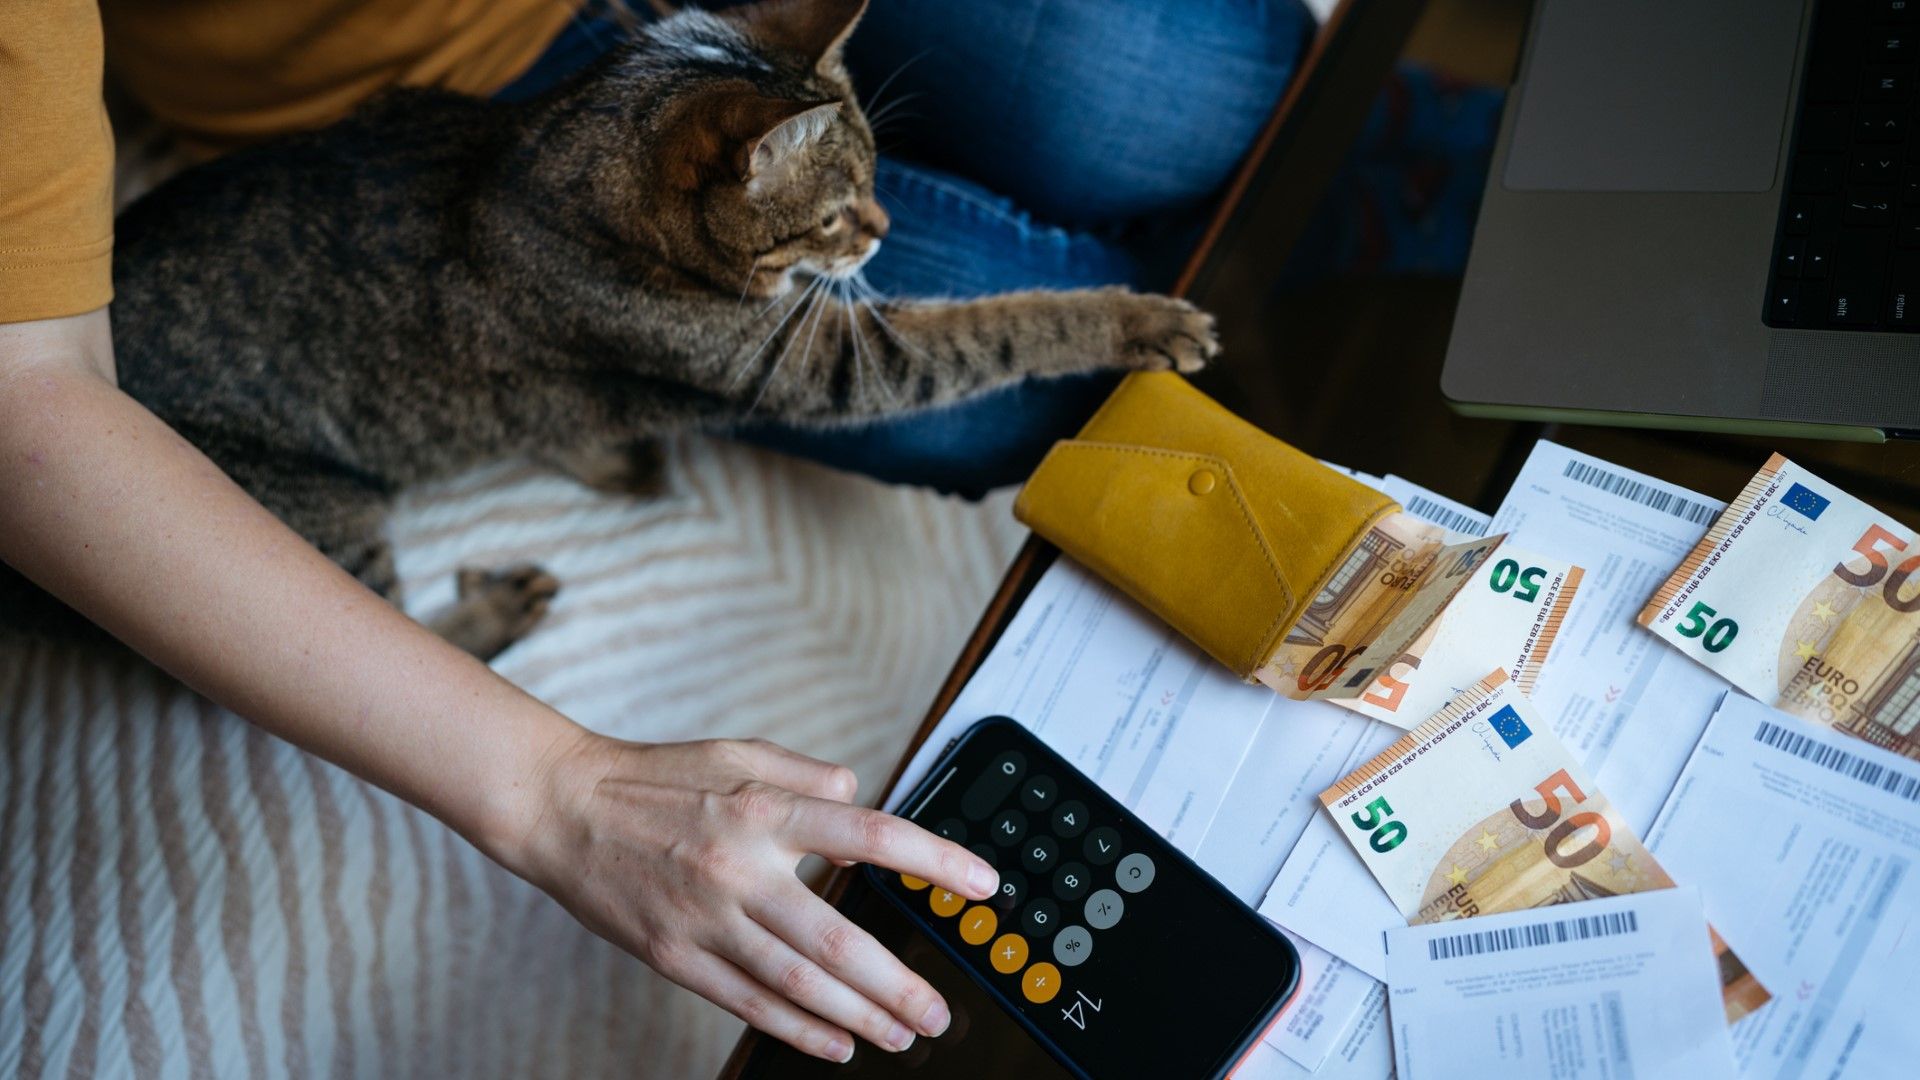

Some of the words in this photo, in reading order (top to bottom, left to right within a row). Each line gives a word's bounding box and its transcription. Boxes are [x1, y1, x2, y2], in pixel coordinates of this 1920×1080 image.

[1887, 40, 1900, 48] N
[1881, 79, 1895, 88] M
[1836, 298, 1848, 316] shift
[1895, 294, 1905, 319] return
[1674, 593, 1688, 608] ECB
[1697, 566, 1711, 580] EZB
[1708, 551, 1721, 566] EKP
[1730, 524, 1744, 539] ESB
[1741, 510, 1756, 525] EKB
[1765, 482, 1779, 497] EBC
[1834, 523, 1920, 613] 50
[1489, 558, 1548, 604] 50
[1544, 592, 1555, 607] ECB
[1530, 623, 1541, 638] EZB
[1674, 600, 1740, 654] 50
[1523, 638, 1534, 653] EKP
[1803, 656, 1859, 695] EURO
[1357, 784, 1373, 797] ECB
[1388, 763, 1403, 776] EZB
[1402, 752, 1417, 766] EKP
[1431, 732, 1447, 745] ESB
[1446, 721, 1462, 734] EKB
[1476, 698, 1492, 713] EBC
[1002, 762, 1016, 775] 0
[1032, 789, 1046, 799] 1
[1063, 812, 1076, 826] 4
[1350, 795, 1408, 854] 50
[1509, 768, 1612, 869] 50
[1001, 820, 1016, 834] 2
[1098, 838, 1111, 853] 7
[1033, 847, 1047, 862] 5
[1129, 866, 1142, 879] C
[1064, 874, 1079, 888] 8
[1003, 883, 1017, 897] 6
[1447, 883, 1480, 919] EUR
[1034, 910, 1048, 925] 9
[1061, 990, 1102, 1030] 14
